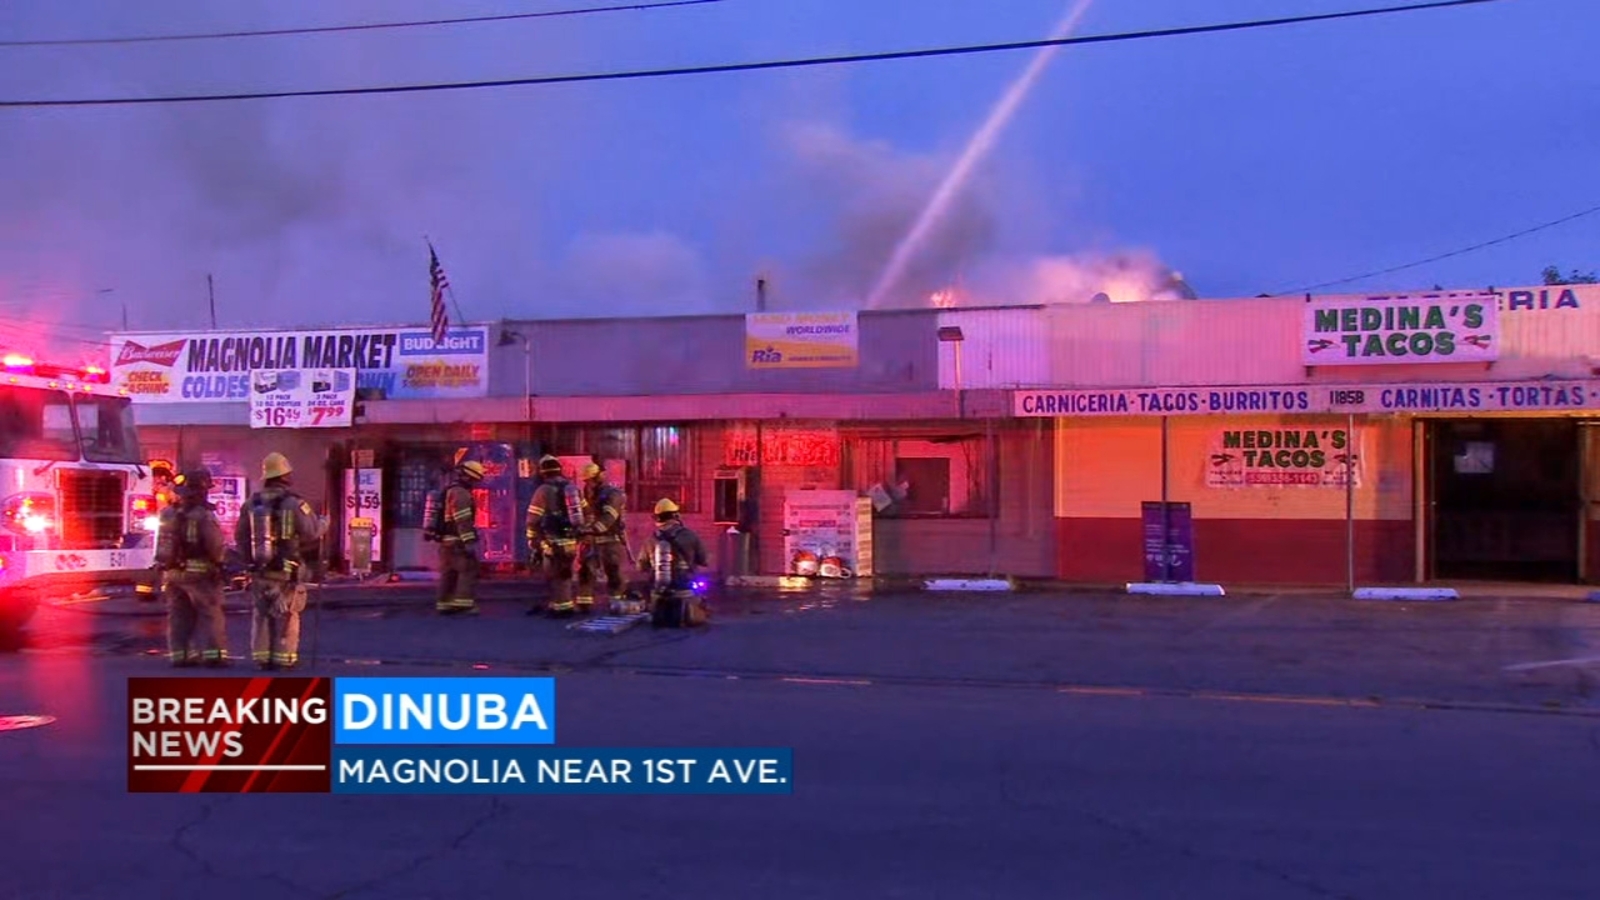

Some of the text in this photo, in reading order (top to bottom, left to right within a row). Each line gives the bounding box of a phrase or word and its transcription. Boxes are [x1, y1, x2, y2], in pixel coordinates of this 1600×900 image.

[1314, 304, 1483, 332] MEDINA'S
[786, 325, 850, 334] WORLDWIDE
[187, 334, 396, 372] MAGNOLIA MARKET
[404, 338, 434, 350] BUD
[1341, 332, 1456, 357] TACOS
[752, 345, 782, 363] Ria
[128, 371, 162, 382] CHECK
[406, 364, 480, 378] OPEN DAILY
[1022, 390, 1309, 414] CARNICERIA TACOS BURRITOS
[1381, 386, 1584, 408] CARNITAS TORTAS
[1223, 430, 1346, 449] MEDINA'S
[1242, 450, 1325, 468] TACOS
